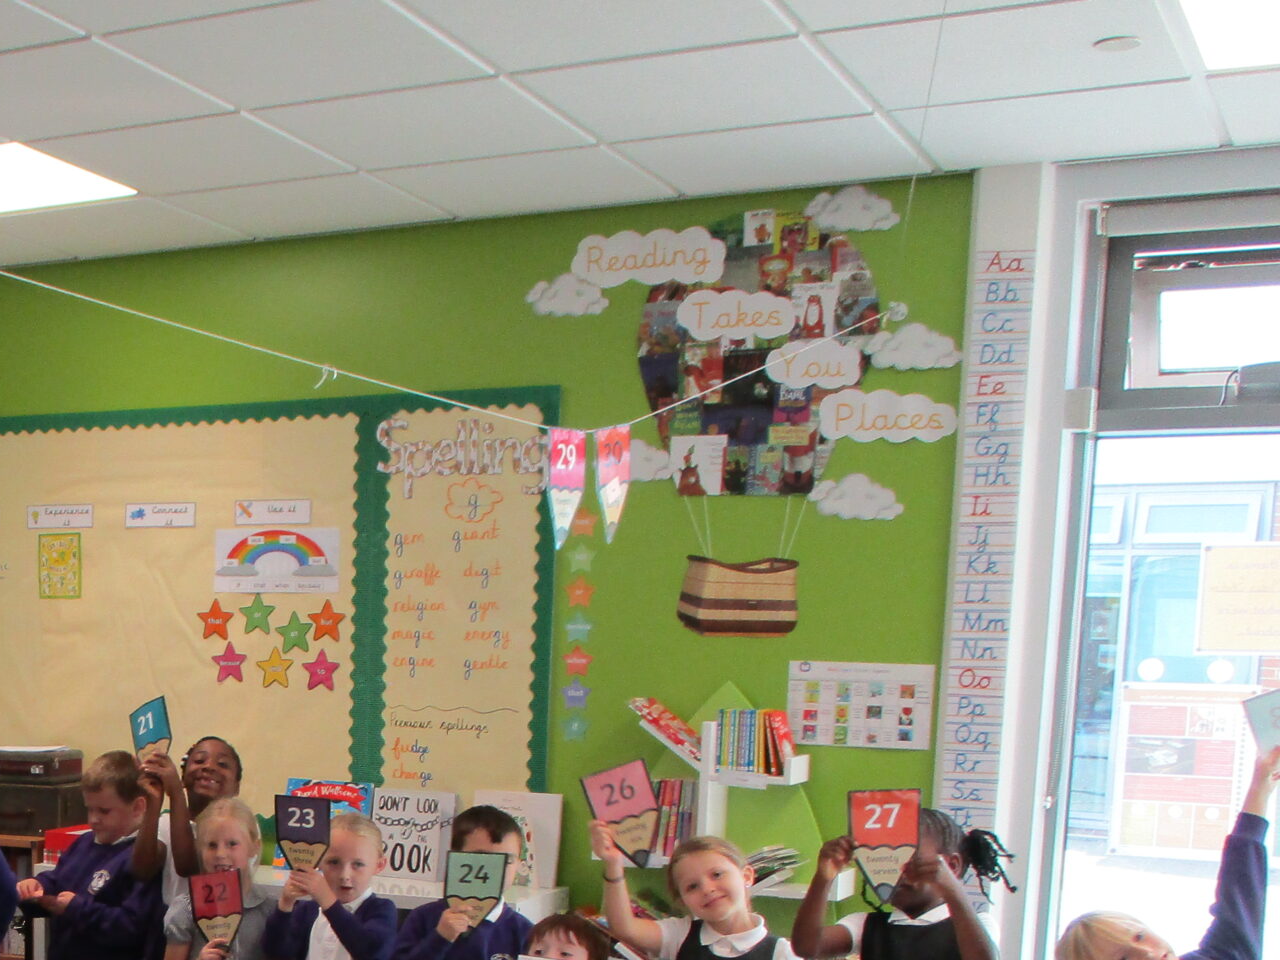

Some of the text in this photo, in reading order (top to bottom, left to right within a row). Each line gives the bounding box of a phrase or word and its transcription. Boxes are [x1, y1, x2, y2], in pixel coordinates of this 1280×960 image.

[586, 240, 711, 276] Reading
[692, 300, 783, 329] Takes
[781, 352, 846, 378] You
[835, 402, 945, 431] Places
[376, 418, 550, 499] Spelling
[556, 443, 577, 470] 29
[467, 494, 479, 520] g
[394, 518, 501, 558] gem giant
[137, 711, 154, 736] 21
[392, 737, 429, 763] fudge
[392, 762, 433, 788] change
[378, 795, 410, 812] DON'T
[599, 778, 636, 807] 26
[287, 807, 315, 828] 23
[863, 803, 901, 829] 27
[458, 863, 490, 884] 24
